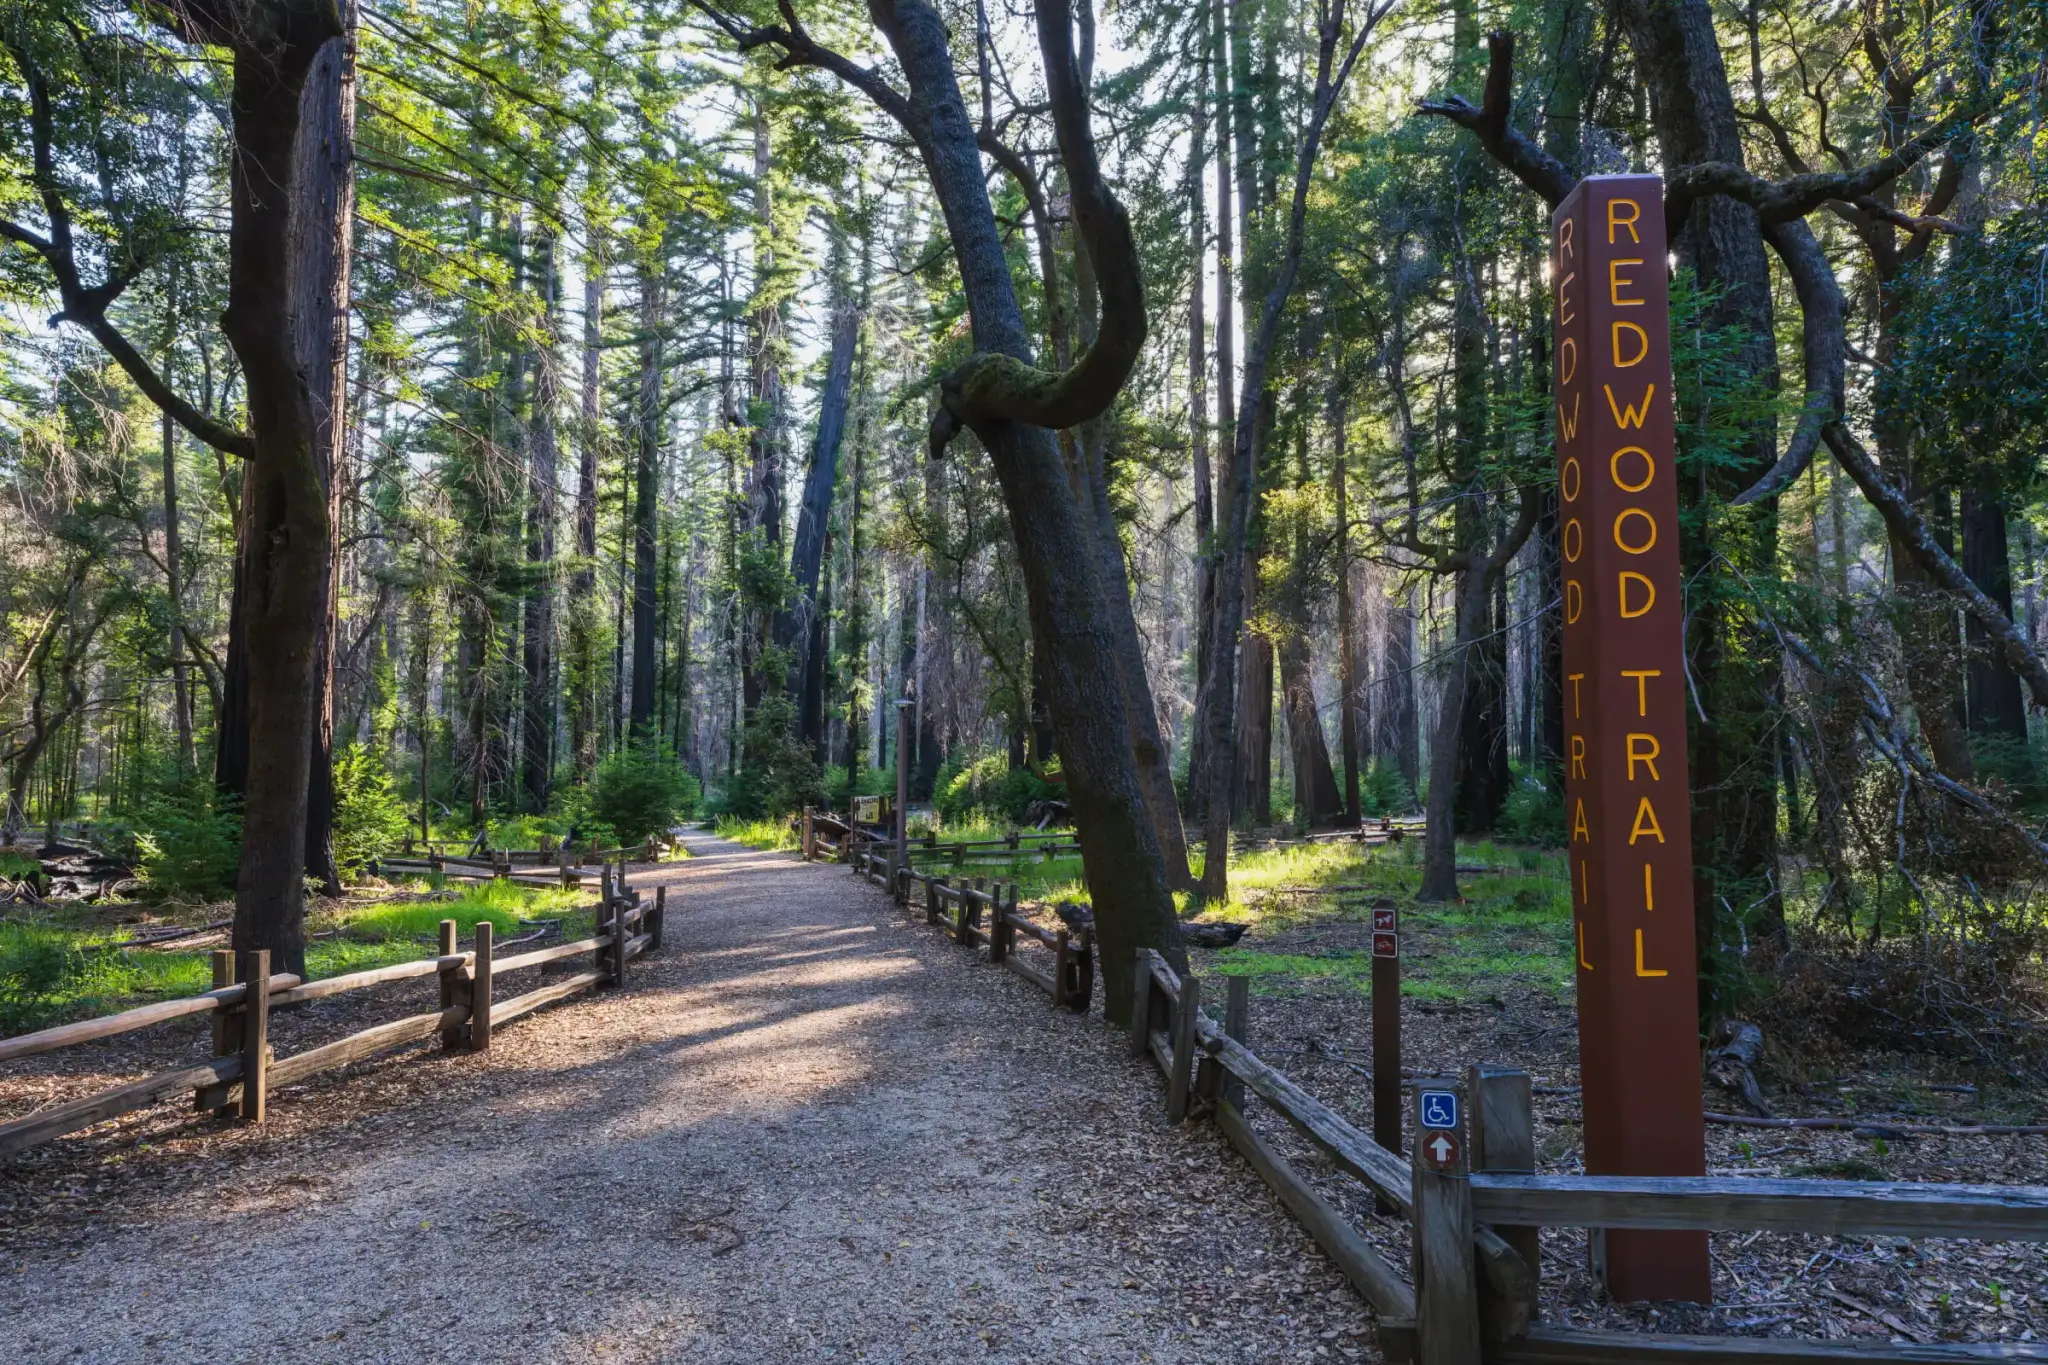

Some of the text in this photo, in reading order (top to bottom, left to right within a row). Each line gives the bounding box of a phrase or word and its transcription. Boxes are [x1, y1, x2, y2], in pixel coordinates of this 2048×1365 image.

[1559, 218, 1593, 970] REDWOOD TRAIL
[1604, 198, 1668, 976] REDWOOD TRAIL
